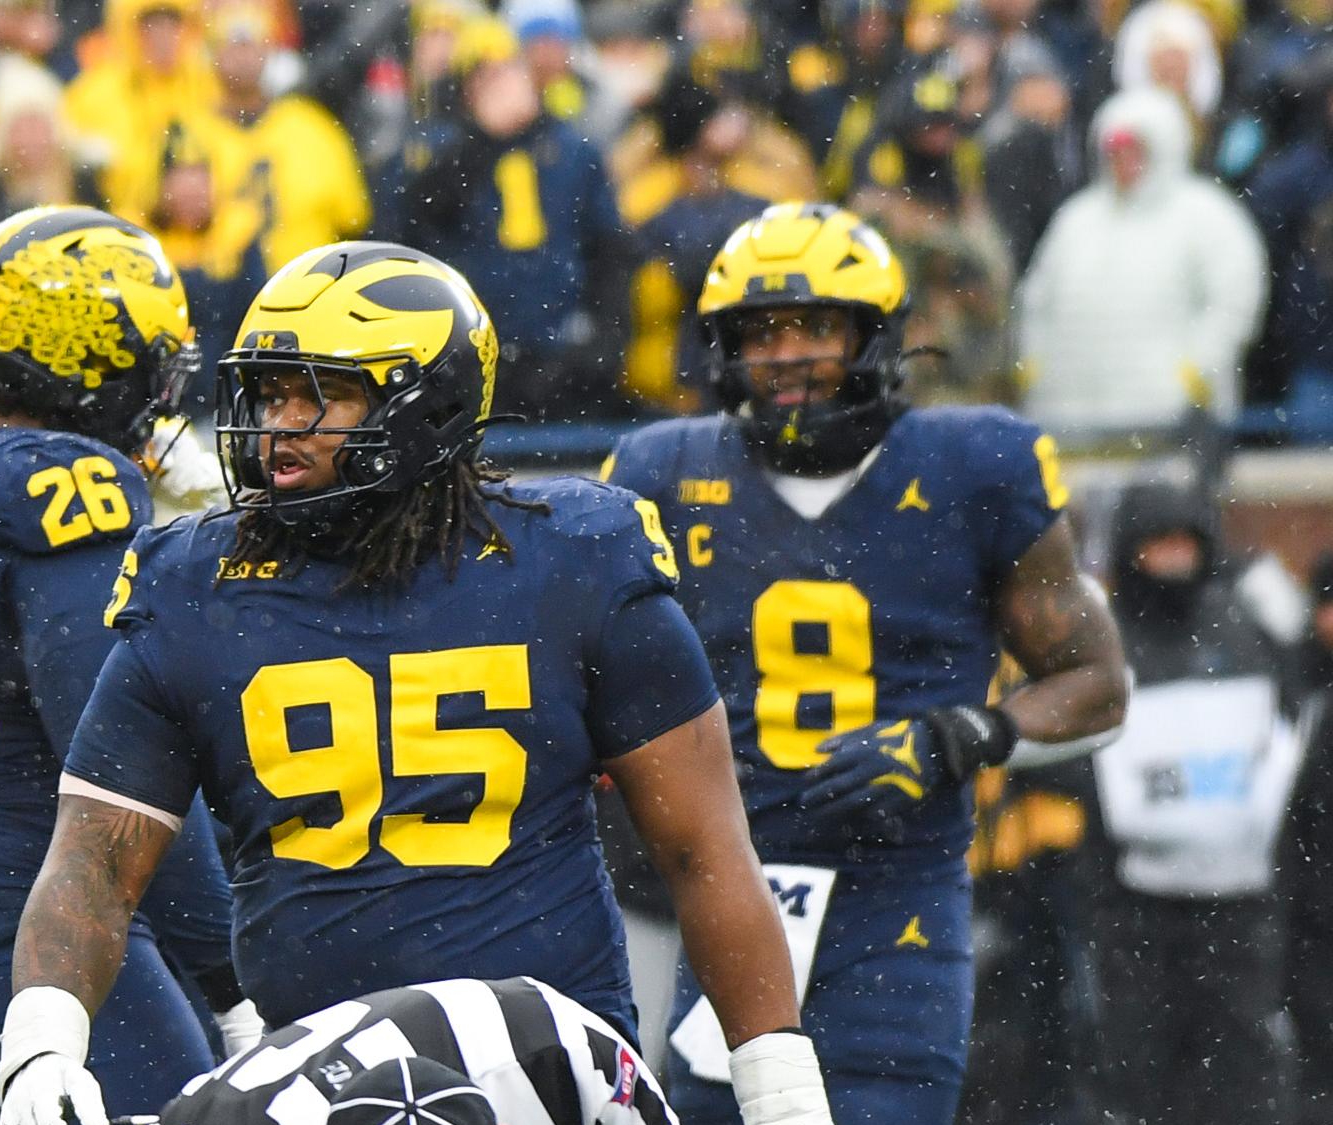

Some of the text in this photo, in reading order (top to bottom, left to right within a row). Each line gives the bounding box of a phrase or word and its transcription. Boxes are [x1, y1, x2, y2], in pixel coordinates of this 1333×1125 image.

[27, 455, 131, 547] 26
[687, 523, 713, 567] C
[751, 578, 876, 771] 8
[240, 643, 532, 870] 95
